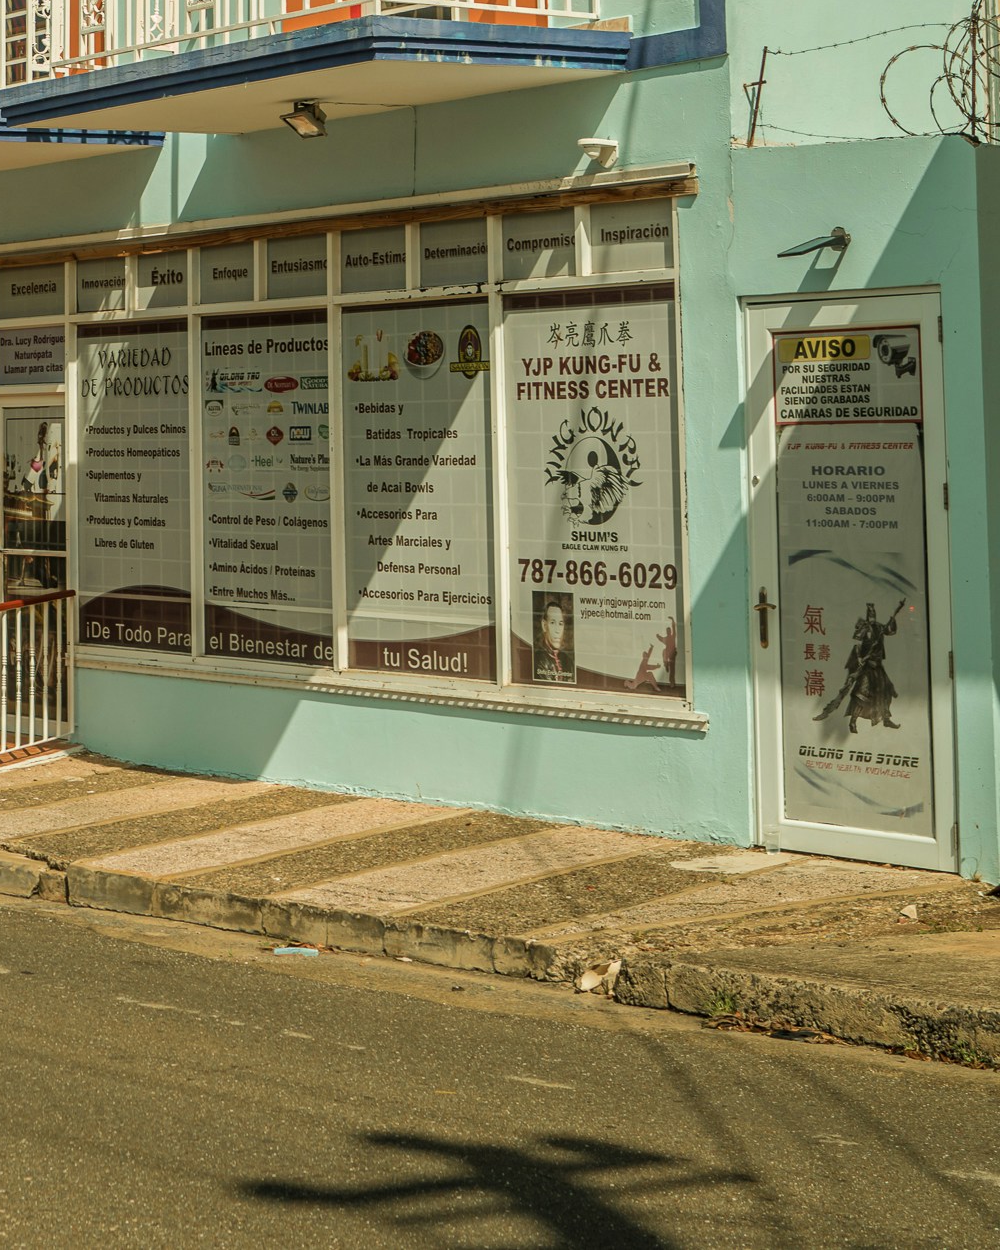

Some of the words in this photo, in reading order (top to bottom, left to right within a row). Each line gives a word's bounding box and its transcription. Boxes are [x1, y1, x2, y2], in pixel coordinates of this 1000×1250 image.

[601, 223, 669, 243] Inspiración
[151, 267, 183, 286] Éxito
[212, 267, 248, 281] Enfoque
[11, 280, 57, 296] Excelencia
[0, 337, 14, 347] Dra.
[15, 336, 32, 347] Lucy
[204, 341, 244, 356] Líneas
[247, 339, 262, 355] de
[266, 337, 328, 354] Productos
[14, 349, 53, 361] Naturópata
[794, 339, 856, 360] AVISO
[98, 347, 172, 368] VARIEDAD
[4, 364, 27, 374] Llamar
[29, 365, 44, 375] para
[46, 362, 63, 372] citas
[521, 357, 553, 377] YJP
[559, 353, 641, 375] KUNG-FU
[648, 352, 662, 372] &
[782, 365, 801, 374] POR
[802, 364, 815, 373] SU
[817, 362, 870, 373] SEGURIDAD
[802, 374, 850, 384] NUESTRAS
[81, 378, 98, 397] DE
[104, 375, 189, 397] PRODUCTOS
[516, 380, 589, 400] FITNESS
[595, 378, 670, 399] CENTER
[781, 385, 838, 395] FACILIDADES
[840, 384, 870, 393] ESTAN
[784, 396, 818, 406] SIENDO
[820, 395, 870, 405] GRABADAS
[358, 402, 396, 414] Bebidas
[398, 404, 404, 416] y
[780, 408, 833, 419] CAMARAS
[835, 407, 850, 418] DE
[853, 406, 918, 418] SEGURIDAD
[88, 425, 125, 435] Productos
[126, 427, 131, 437] y
[132, 424, 158, 434] Dulces
[160, 424, 186, 434] Chinos
[366, 428, 402, 440] Batidas
[406, 427, 458, 442] Tropicales
[88, 447, 125, 457] Productos
[126, 447, 180, 459] Homeopáticos
[289, 454, 316, 465] Nature's
[360, 455, 371, 466] La
[373, 455, 393, 466] Más
[395, 454, 430, 466] Grande
[432, 454, 476, 466] Variedad
[88, 470, 135, 482] Suplementos
[137, 472, 142, 482] y
[811, 465, 885, 476] HORARIO
[366, 481, 379, 493] de
[381, 481, 402, 493] Acai
[405, 482, 434, 493] Bowls
[802, 480, 838, 489] LUNES
[840, 481, 848, 489] A
[851, 481, 899, 490] VIERNES
[94, 492, 131, 503] Vitaminas
[132, 493, 169, 504] Naturales
[806, 493, 845, 503] 6:00AM
[856, 494, 895, 503] 9:00PM
[360, 508, 413, 520] Accesorios
[415, 508, 438, 521] Para
[825, 506, 877, 516] SABADOS
[89, 515, 126, 526] Productos
[127, 518, 132, 528] y
[133, 516, 166, 527] Comidas
[211, 514, 241, 525] Control
[243, 515, 253, 526] de
[255, 515, 276, 526] Peso
[283, 516, 328, 530] Colágenos
[805, 518, 850, 528] 11:00AM
[859, 520, 898, 529] 7:00PM
[94, 537, 117, 549] Libres
[118, 538, 128, 549] de
[129, 539, 155, 550] Gluten
[211, 538, 248, 549] Vitalidad
[249, 539, 279, 551] Sexual
[368, 534, 393, 546] Artes
[395, 535, 443, 548] Marciales
[445, 539, 452, 551] y
[562, 543, 581, 551] EAGLE
[212, 562, 238, 573] Amino
[240, 561, 268, 575] Ácidos
[377, 561, 415, 574] Defensa
[418, 562, 461, 576] Personal
[518, 558, 677, 590] 787-866-6029
[212, 585, 234, 597] Entre
[236, 587, 268, 600] Muchos
[270, 589, 296, 602] Más...
[362, 587, 415, 601] Accesorios
[417, 589, 439, 603] Para
[442, 591, 492, 606] Ejercicios
[580, 597, 665, 610] www.yingjowpaipr.com
[115, 623, 152, 643] Todo
[157, 627, 192, 647] Para
[209, 632, 223, 650] el
[229, 633, 307, 658] Bienestar
[313, 642, 333, 661] de
[383, 647, 400, 668] tu
[408, 648, 468, 673] Salud!
[849, 750, 872, 763] TAO
[875, 753, 919, 768] STORE
